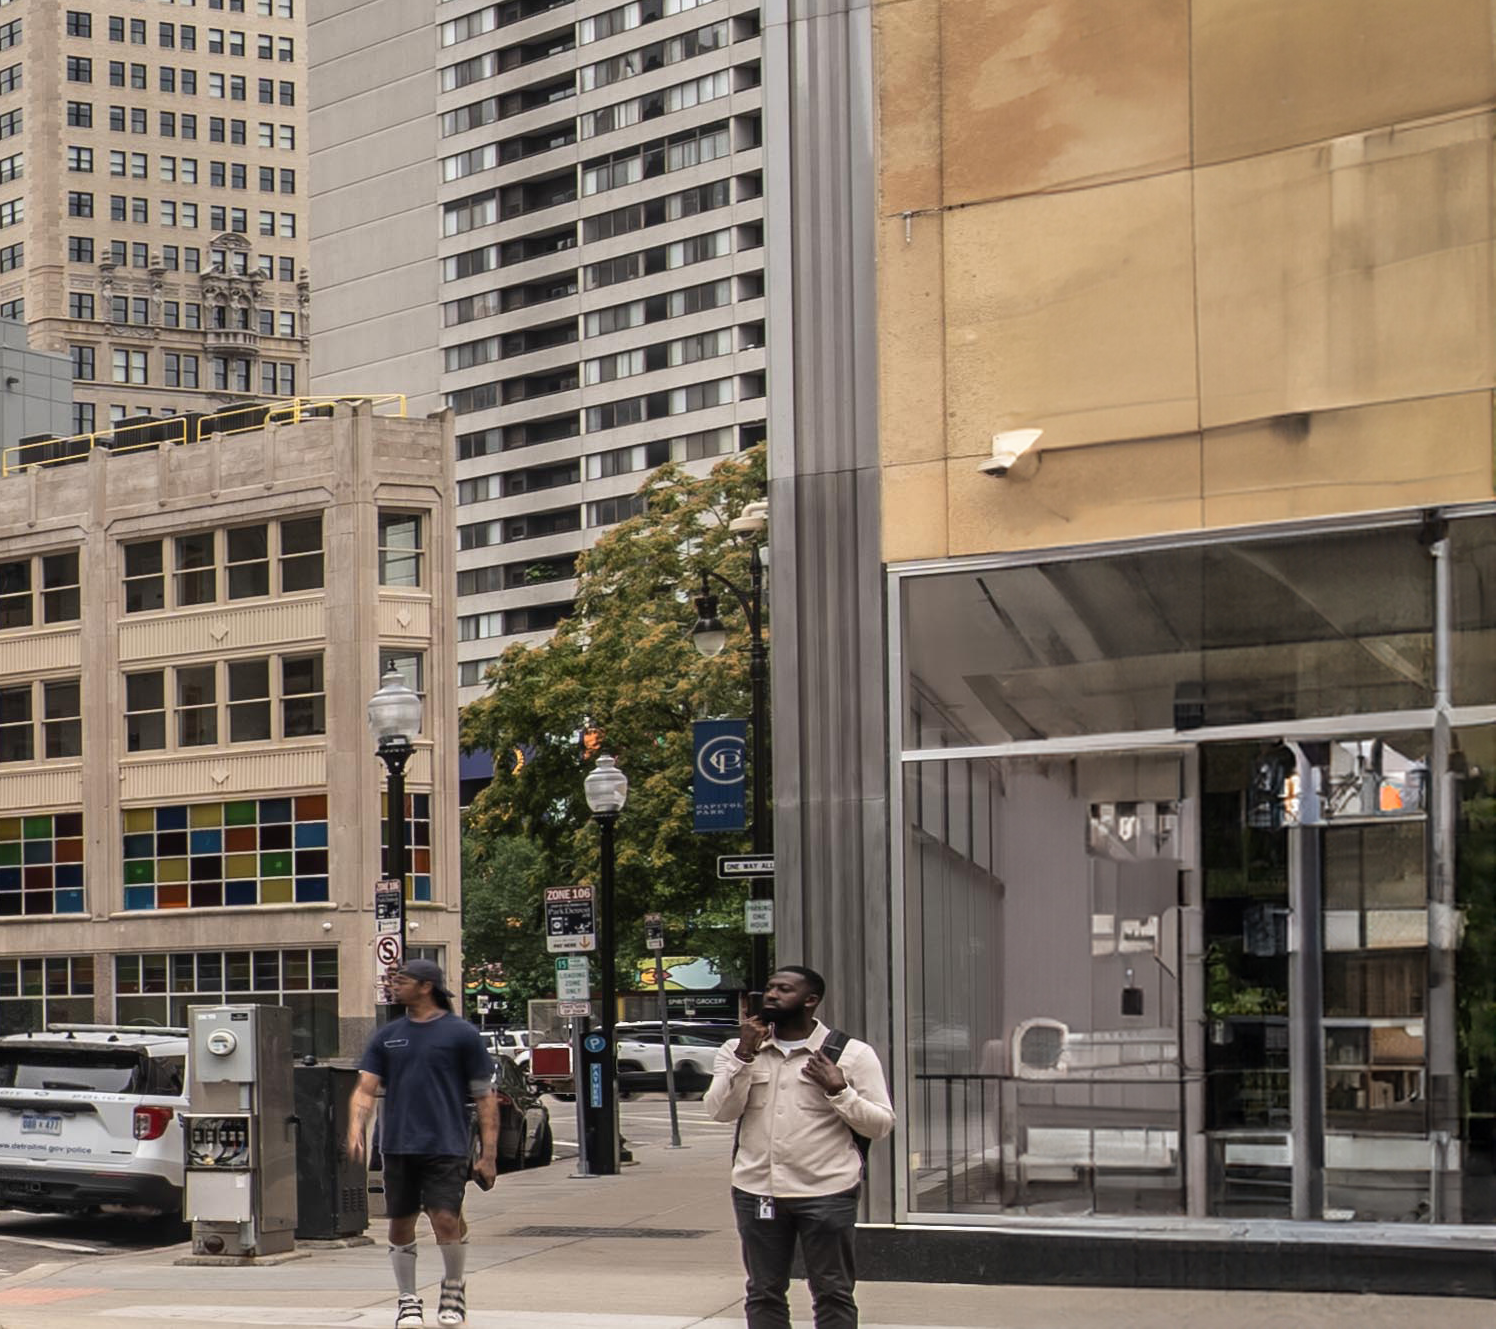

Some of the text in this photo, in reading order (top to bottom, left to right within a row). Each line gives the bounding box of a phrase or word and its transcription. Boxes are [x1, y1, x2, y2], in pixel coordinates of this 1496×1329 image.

[696, 802, 743, 810] CAPITOL
[743, 862, 759, 870] WAY
[546, 887, 591, 901] ZONE 106
[695, 997, 727, 1005] GROCERY
